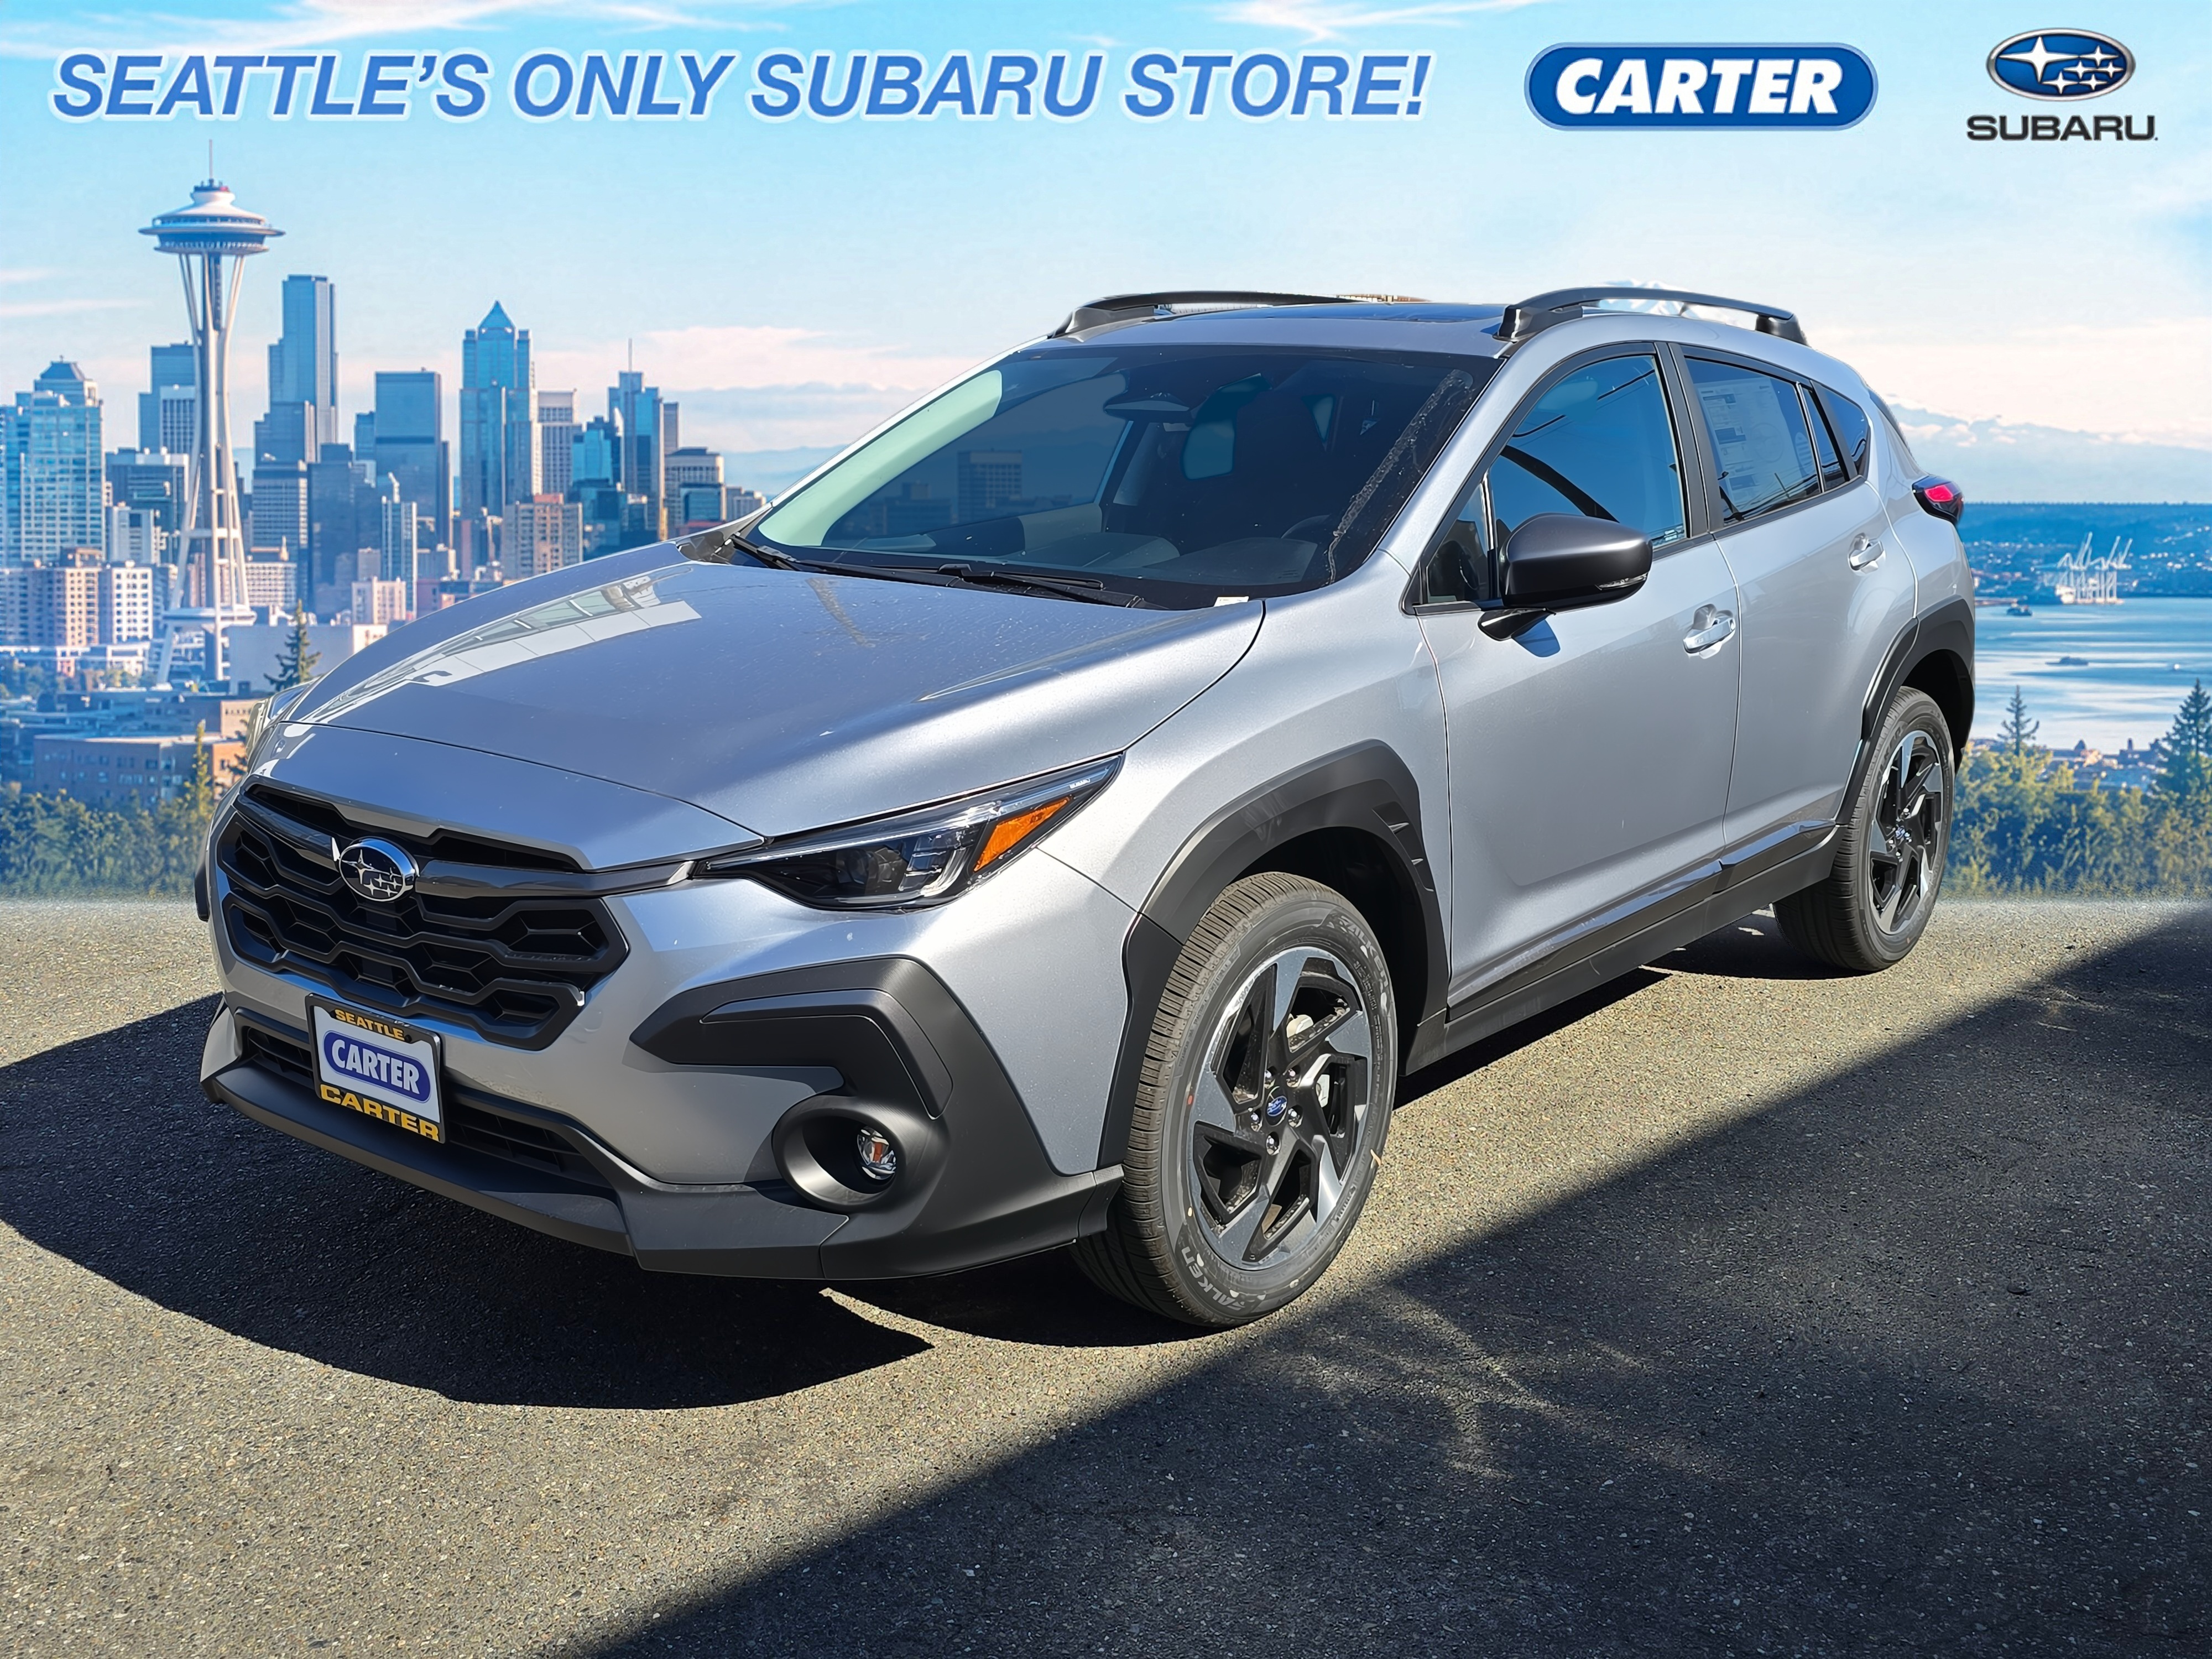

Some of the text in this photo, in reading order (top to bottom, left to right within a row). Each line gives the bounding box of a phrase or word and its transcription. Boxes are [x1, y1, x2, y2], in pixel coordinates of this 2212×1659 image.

[335, 1009, 405, 1041] SEATTLE
[331, 1039, 420, 1094] CARTER
[320, 1084, 440, 1141] CARTER
[1181, 1246, 1246, 1311] FALKEN
